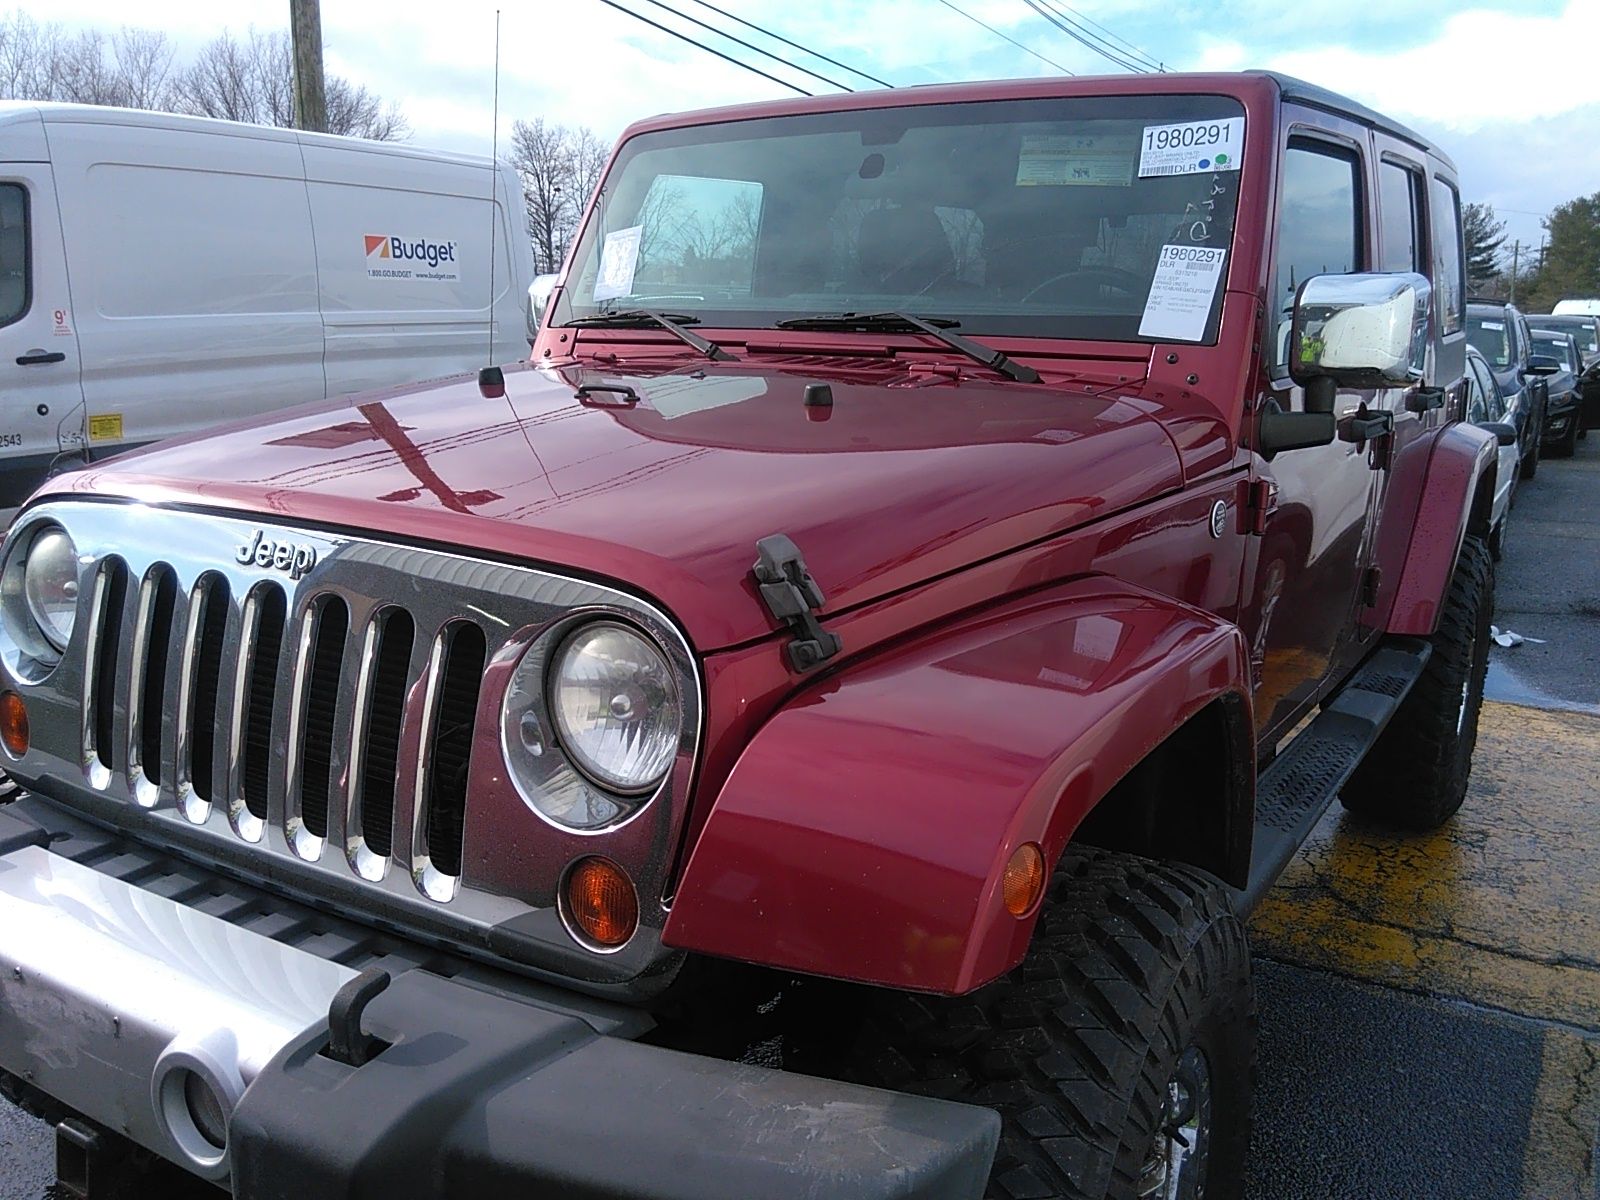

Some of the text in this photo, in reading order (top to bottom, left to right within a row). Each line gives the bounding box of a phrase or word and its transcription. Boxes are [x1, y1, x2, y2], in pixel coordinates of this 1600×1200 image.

[1146, 123, 1230, 150] 1980291
[1174, 163, 1197, 173] DLR
[391, 237, 455, 267] Budget
[1163, 247, 1223, 263] 1980291
[416, 272, 457, 280] www.budget.com
[235, 529, 317, 580] Jeep
